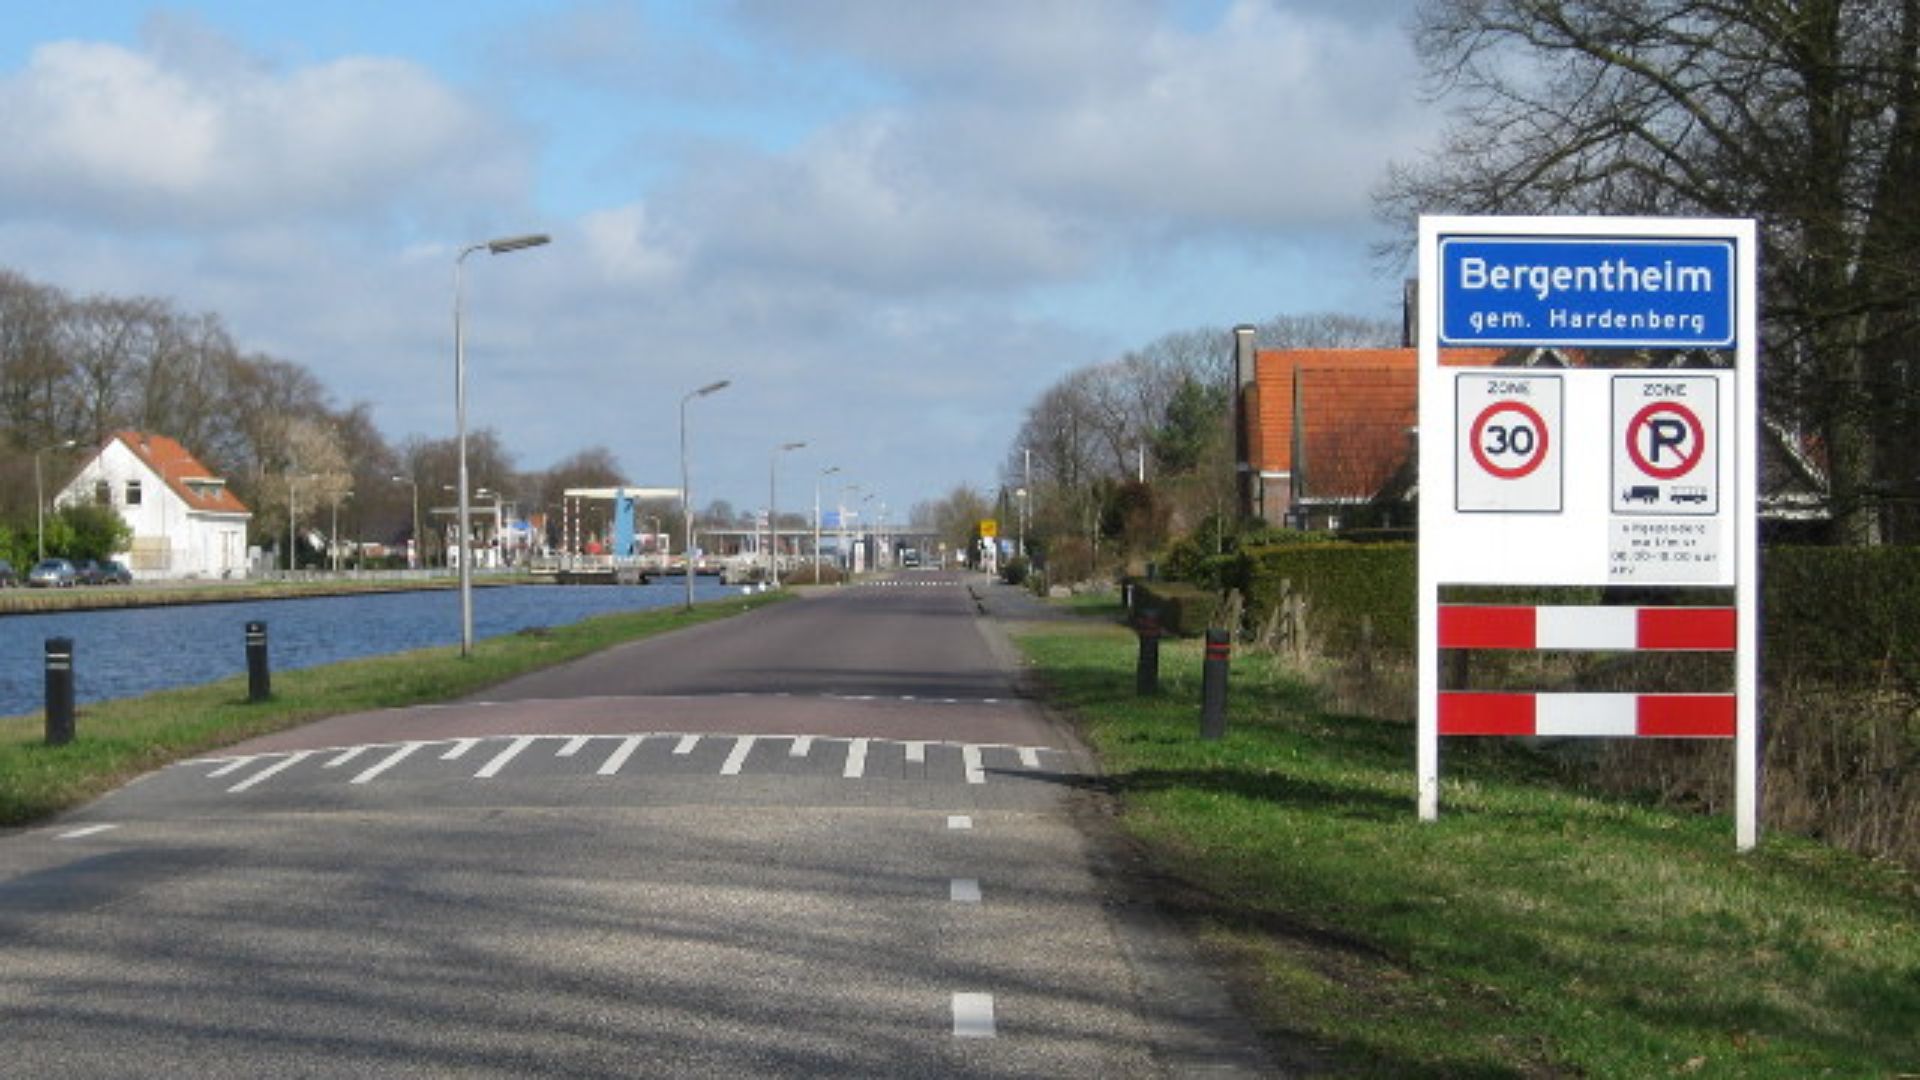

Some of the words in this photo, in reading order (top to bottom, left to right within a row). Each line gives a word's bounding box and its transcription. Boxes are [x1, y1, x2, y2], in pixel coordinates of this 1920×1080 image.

[1460, 257, 1711, 300] Bergentheim
[1469, 310, 1531, 332] gem.
[1549, 309, 1706, 334] Hardenberg
[1487, 380, 1529, 395] ZONE
[1643, 383, 1687, 397] ZONE
[1486, 425, 1535, 456] 30
